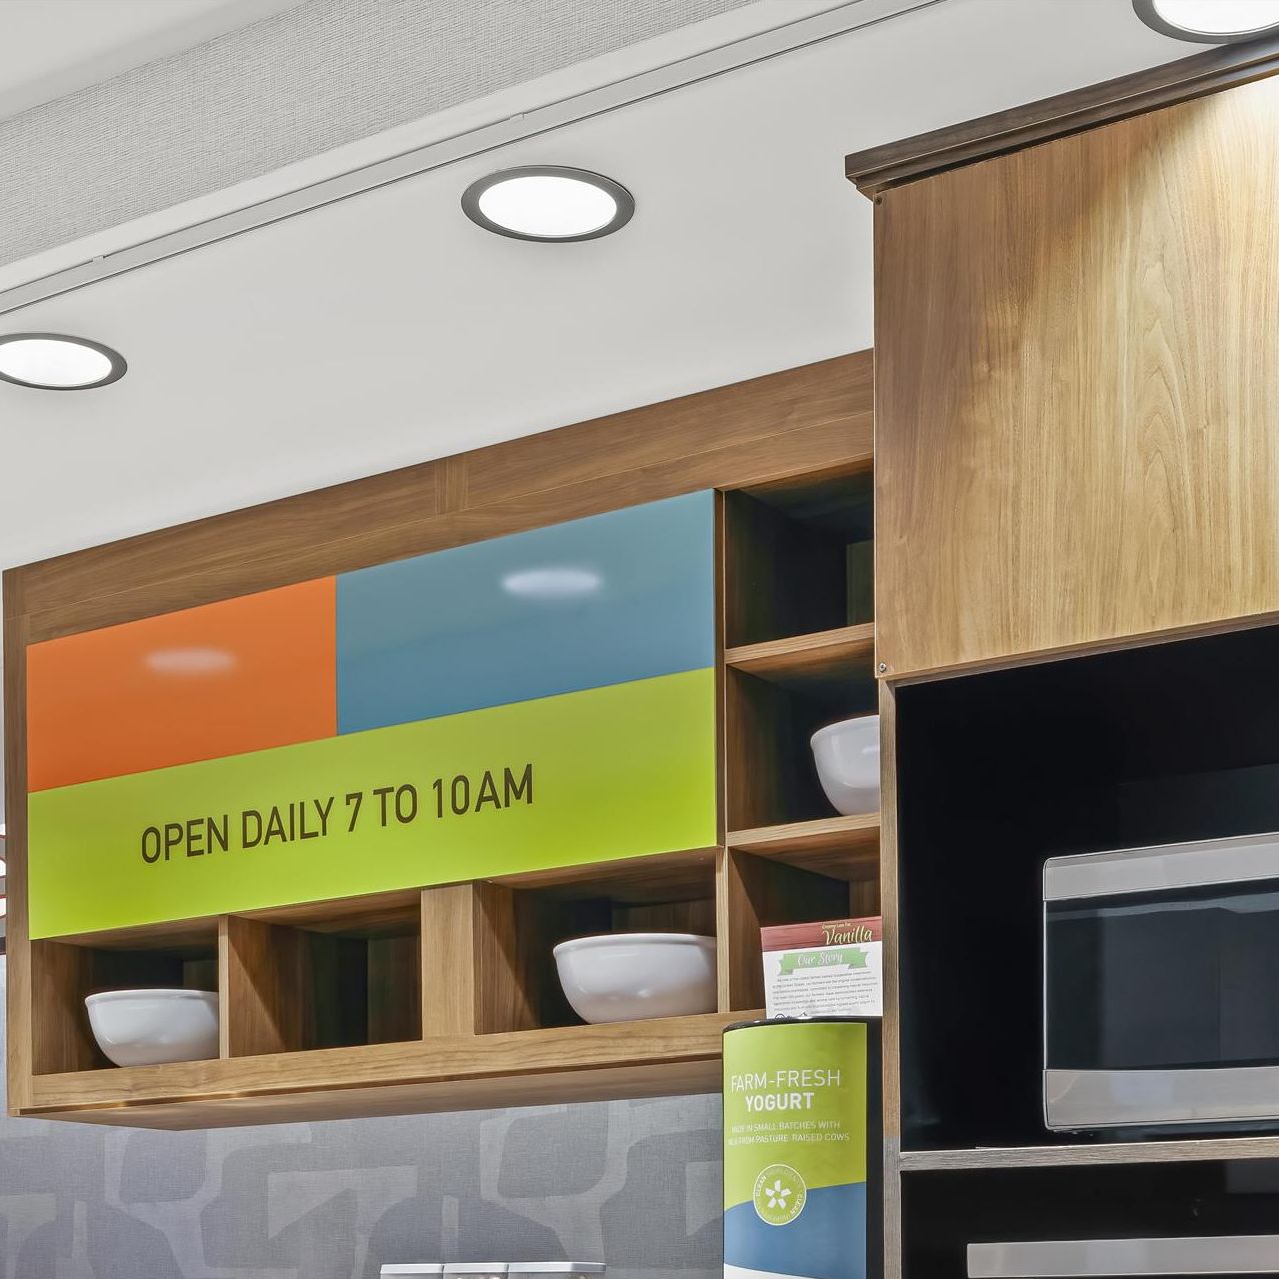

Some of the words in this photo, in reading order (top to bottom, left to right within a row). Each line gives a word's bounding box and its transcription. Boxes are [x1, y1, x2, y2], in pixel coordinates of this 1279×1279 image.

[141, 814, 228, 863] OPEN
[241, 797, 335, 849] DAILY
[345, 792, 363, 832] 7
[373, 784, 418, 827] TO
[822, 925, 873, 945] Vanilla
[731, 1069, 841, 1093] FARM-FRESH
[745, 1092, 815, 1112] YOGURT
